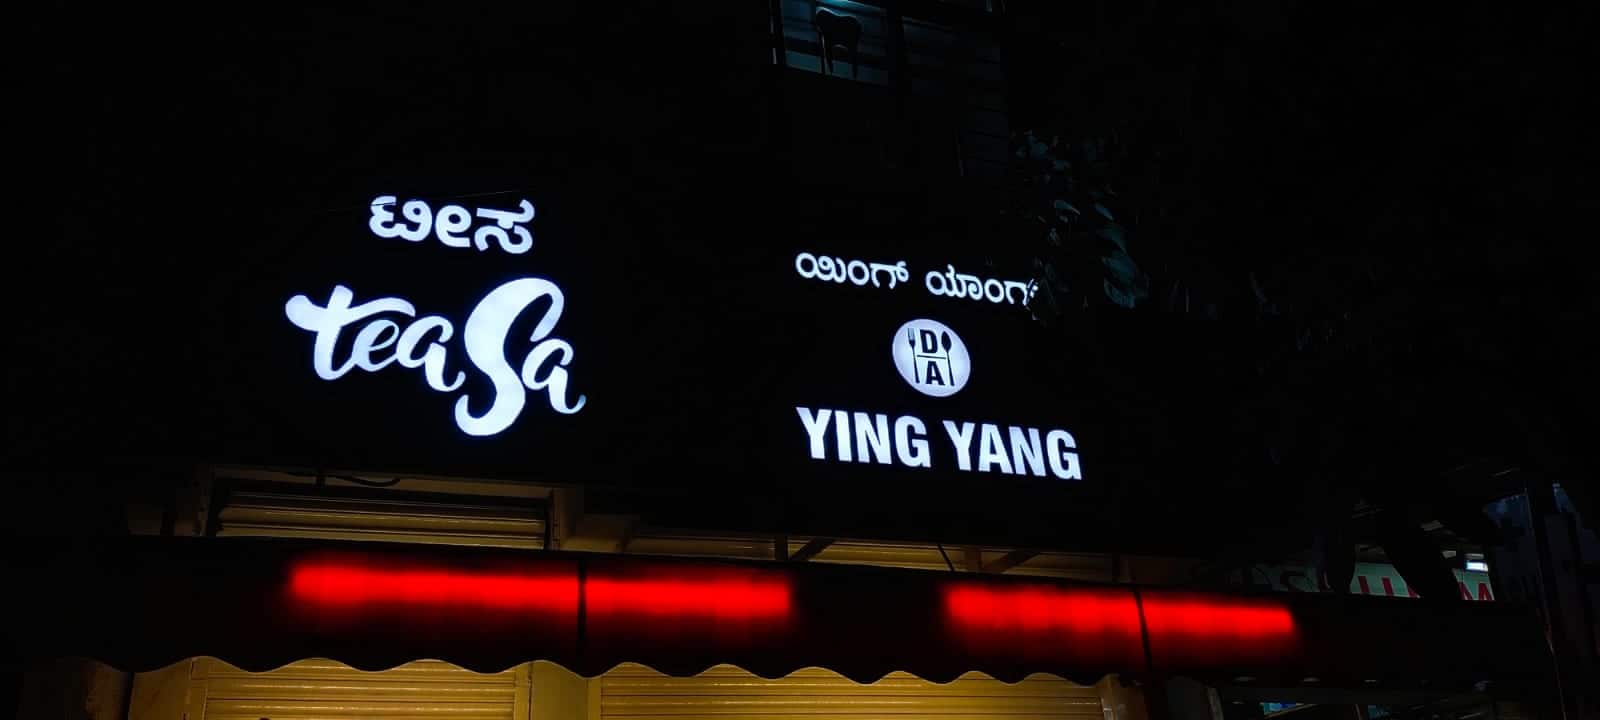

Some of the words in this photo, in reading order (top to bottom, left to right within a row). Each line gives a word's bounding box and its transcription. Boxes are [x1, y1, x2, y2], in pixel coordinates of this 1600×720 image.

[369, 195, 535, 254] ಟೀಸ
[795, 252, 909, 289] ಯಿಂಗ್
[796, 406, 932, 468] YING
[942, 420, 1082, 480] YANG
